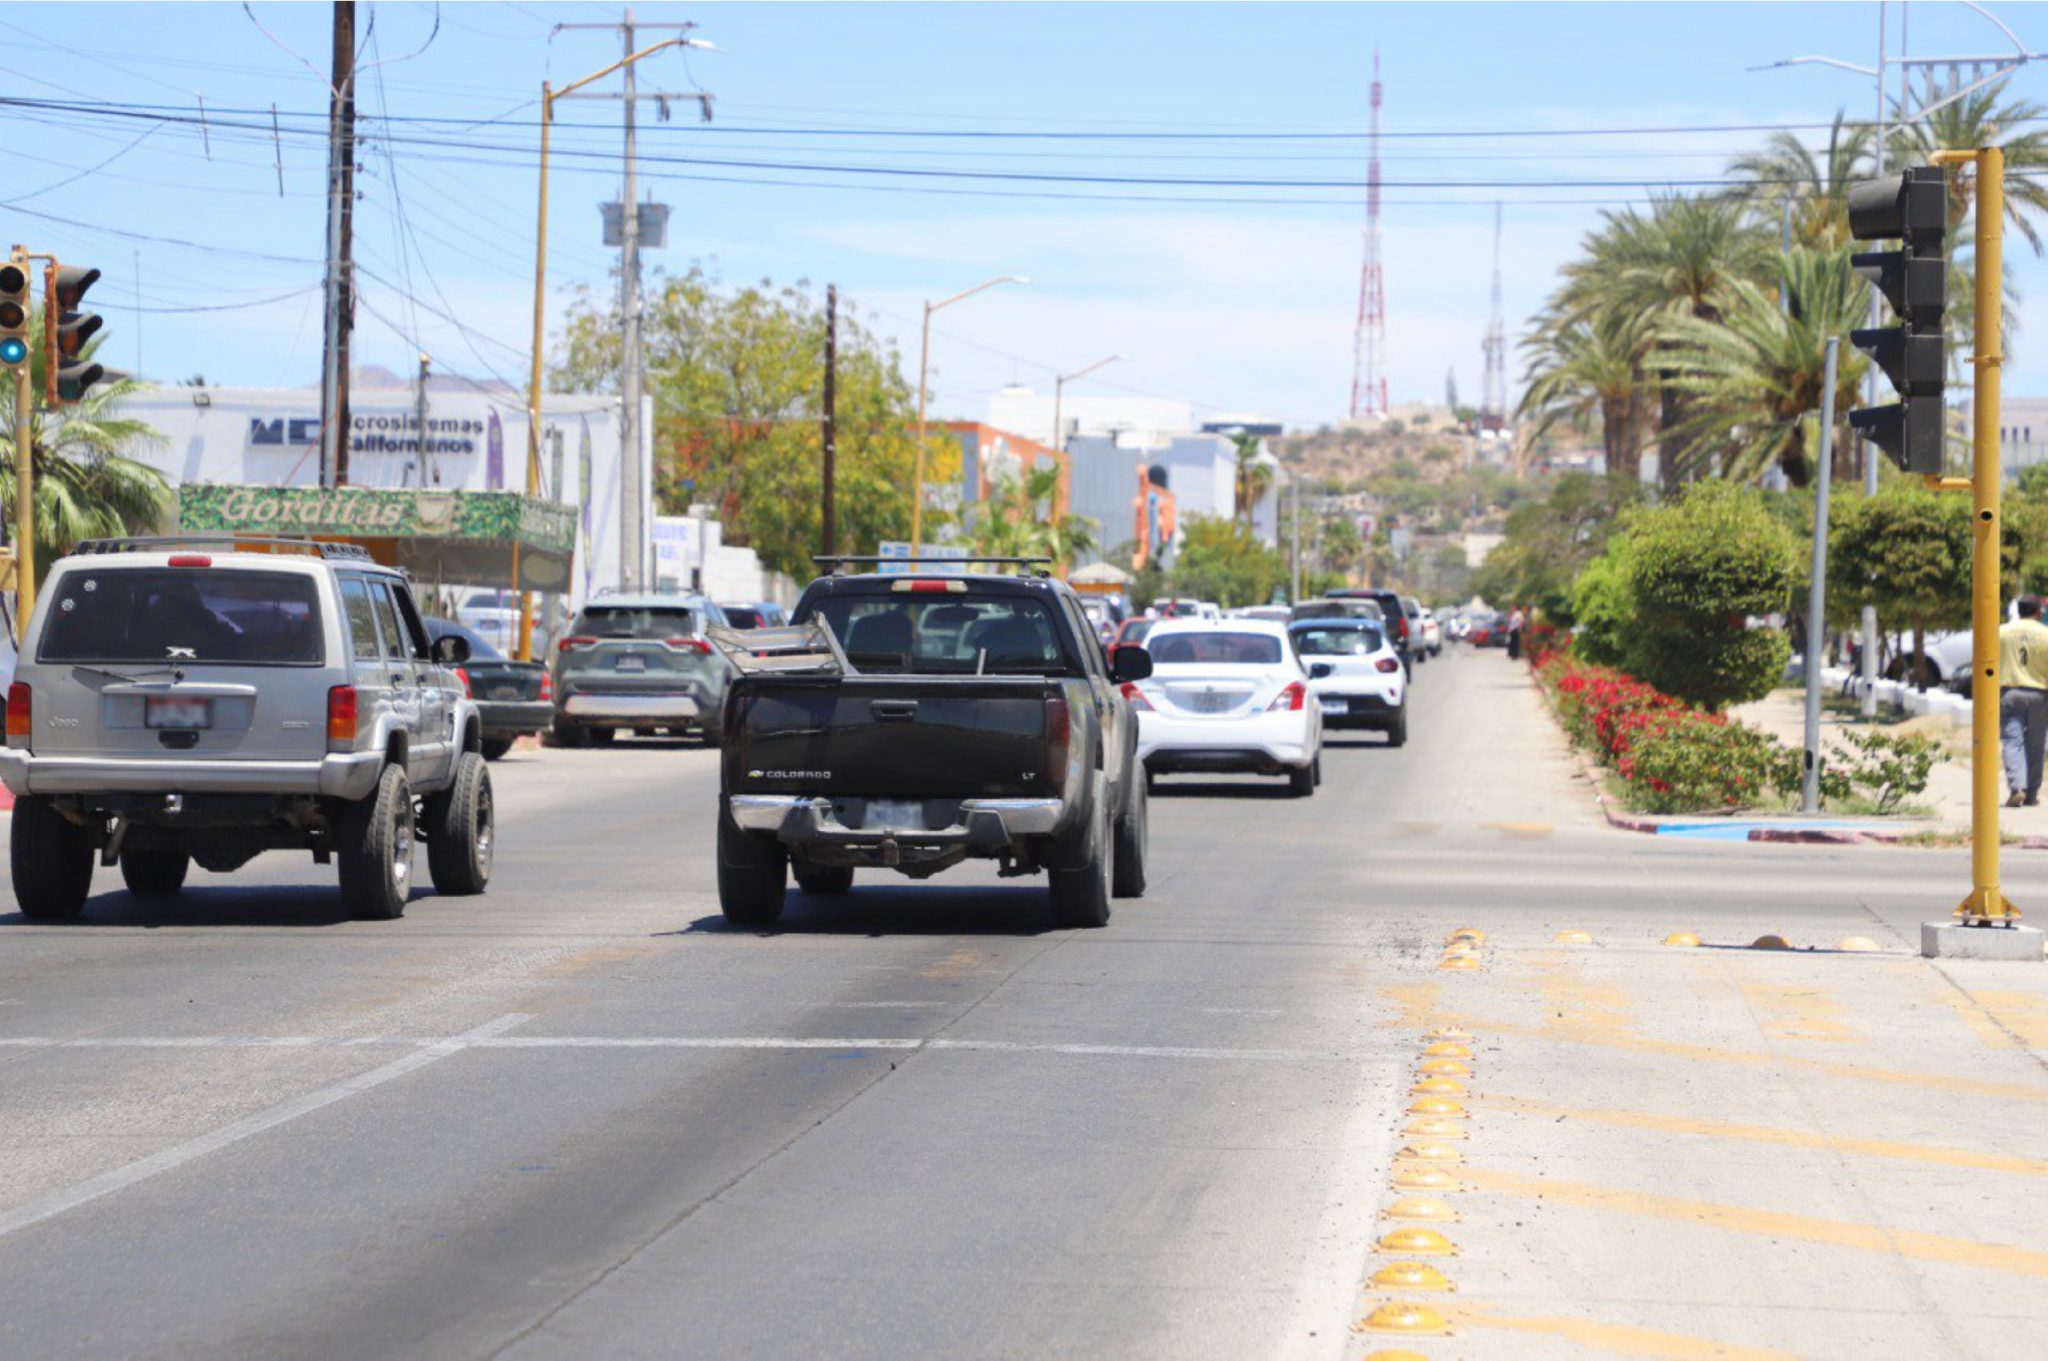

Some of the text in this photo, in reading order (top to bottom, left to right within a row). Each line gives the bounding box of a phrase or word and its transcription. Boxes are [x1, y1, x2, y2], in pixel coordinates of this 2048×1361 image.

[346, 434, 474, 453] alifornanos
[222, 491, 406, 526] Gorditas
[766, 770, 832, 779] COLORADO
[1022, 772, 1035, 780] LT
